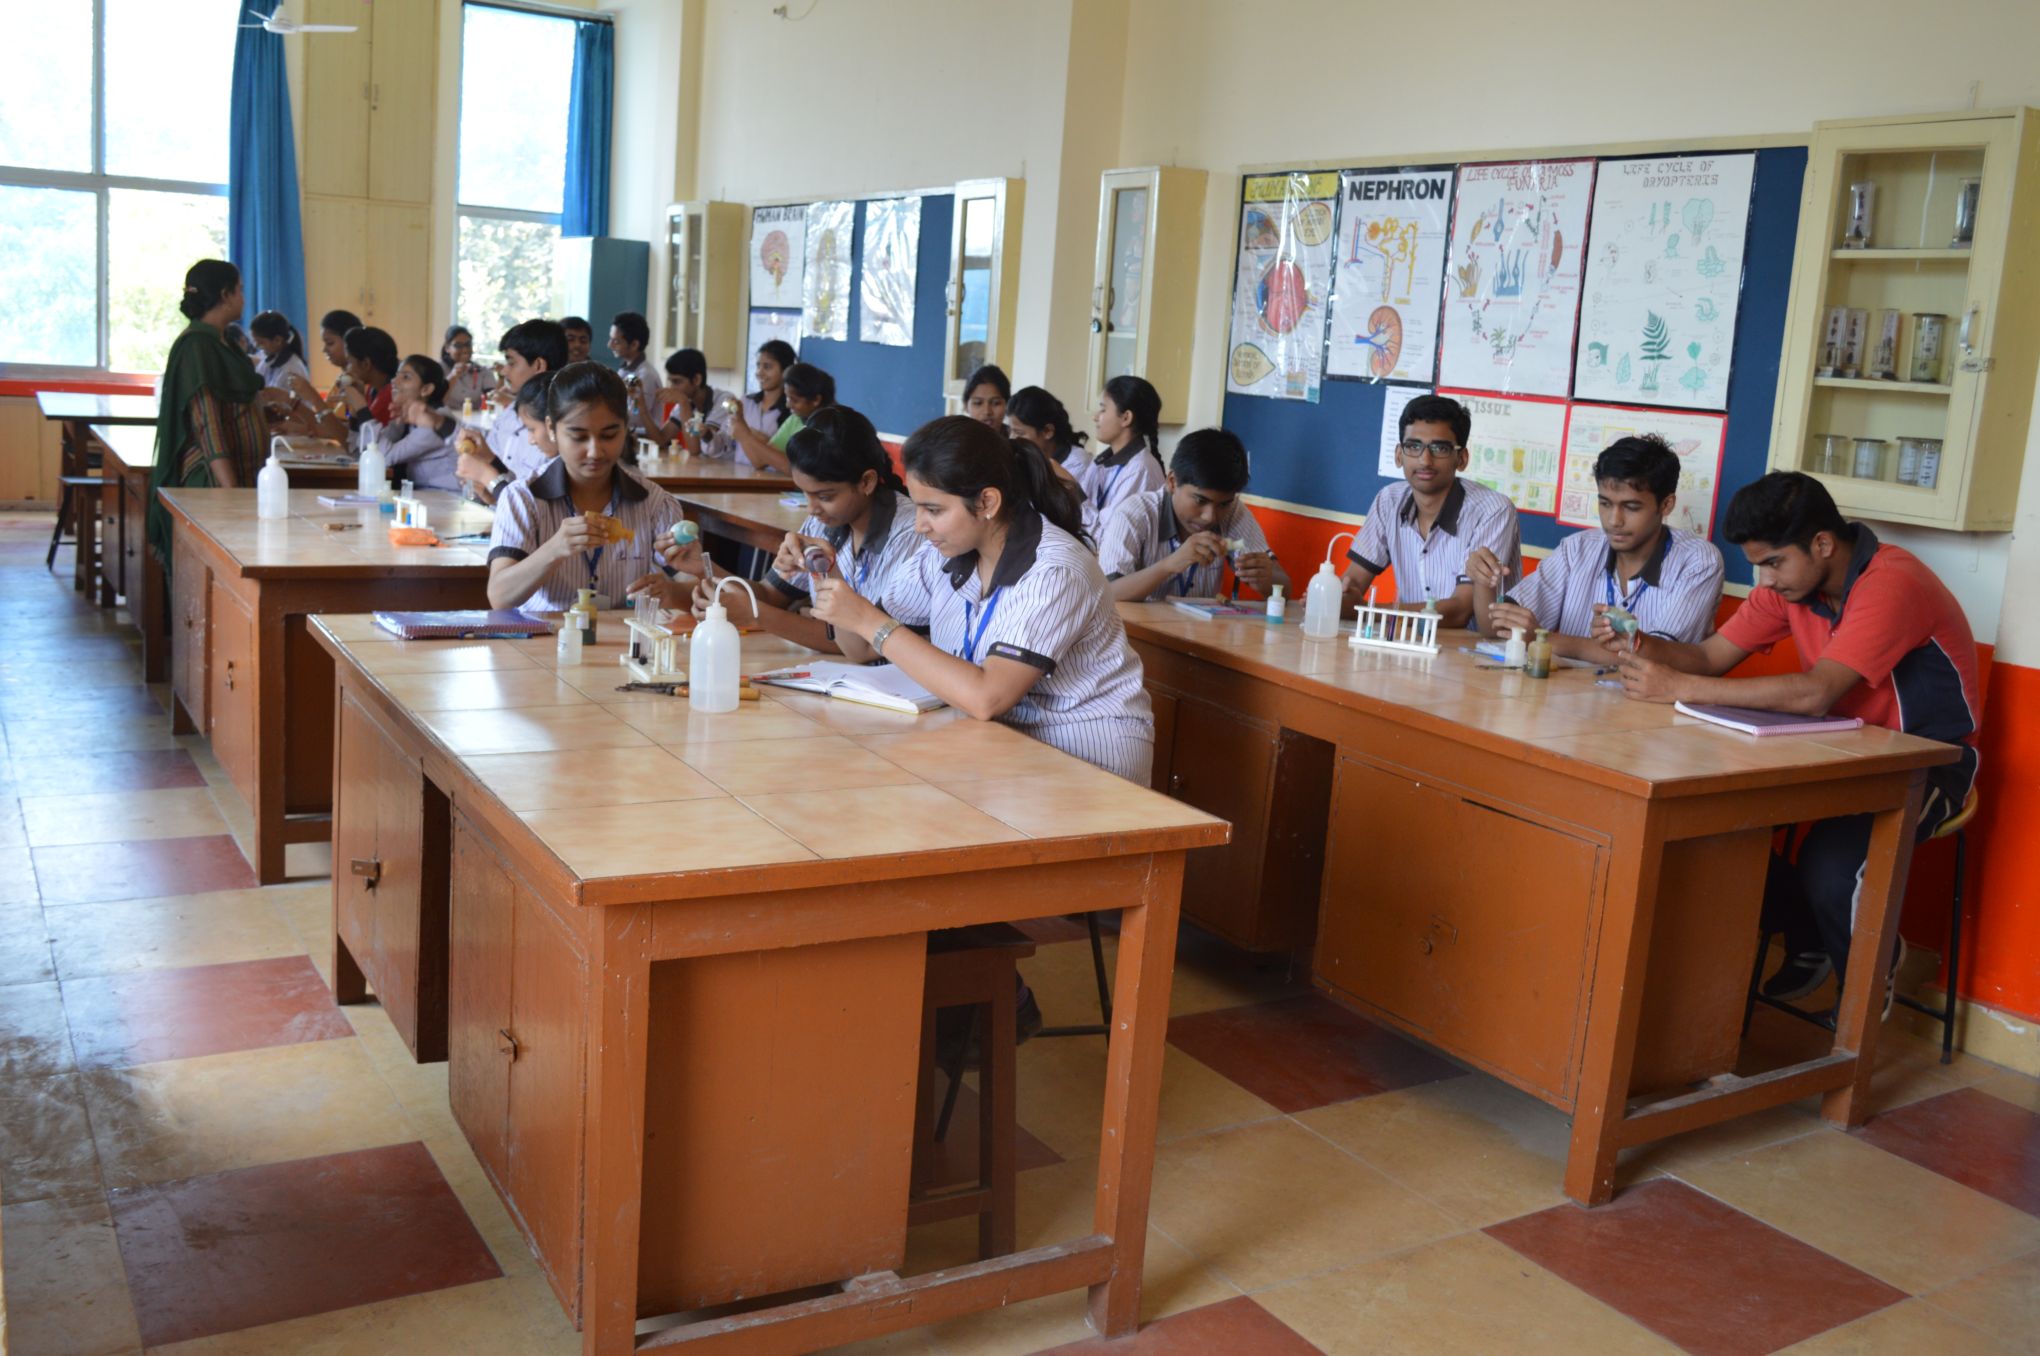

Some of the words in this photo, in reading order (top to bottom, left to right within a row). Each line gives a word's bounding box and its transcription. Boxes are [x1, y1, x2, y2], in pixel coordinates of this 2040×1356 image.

[1466, 168, 1488, 182] LIFE
[1490, 167, 1519, 180] CYCLE
[1548, 163, 1575, 177] MOSS
[1622, 163, 1650, 175] LIFE
[1657, 161, 1693, 173] CYCLE
[1700, 160, 1714, 171] OF
[1642, 174, 1719, 188] DRYOPTERIS
[1348, 179, 1446, 201] NEPHRON
[756, 208, 780, 223] HUMAN
[782, 207, 804, 221] BRAIN
[1460, 396, 1511, 416] TISSUE
